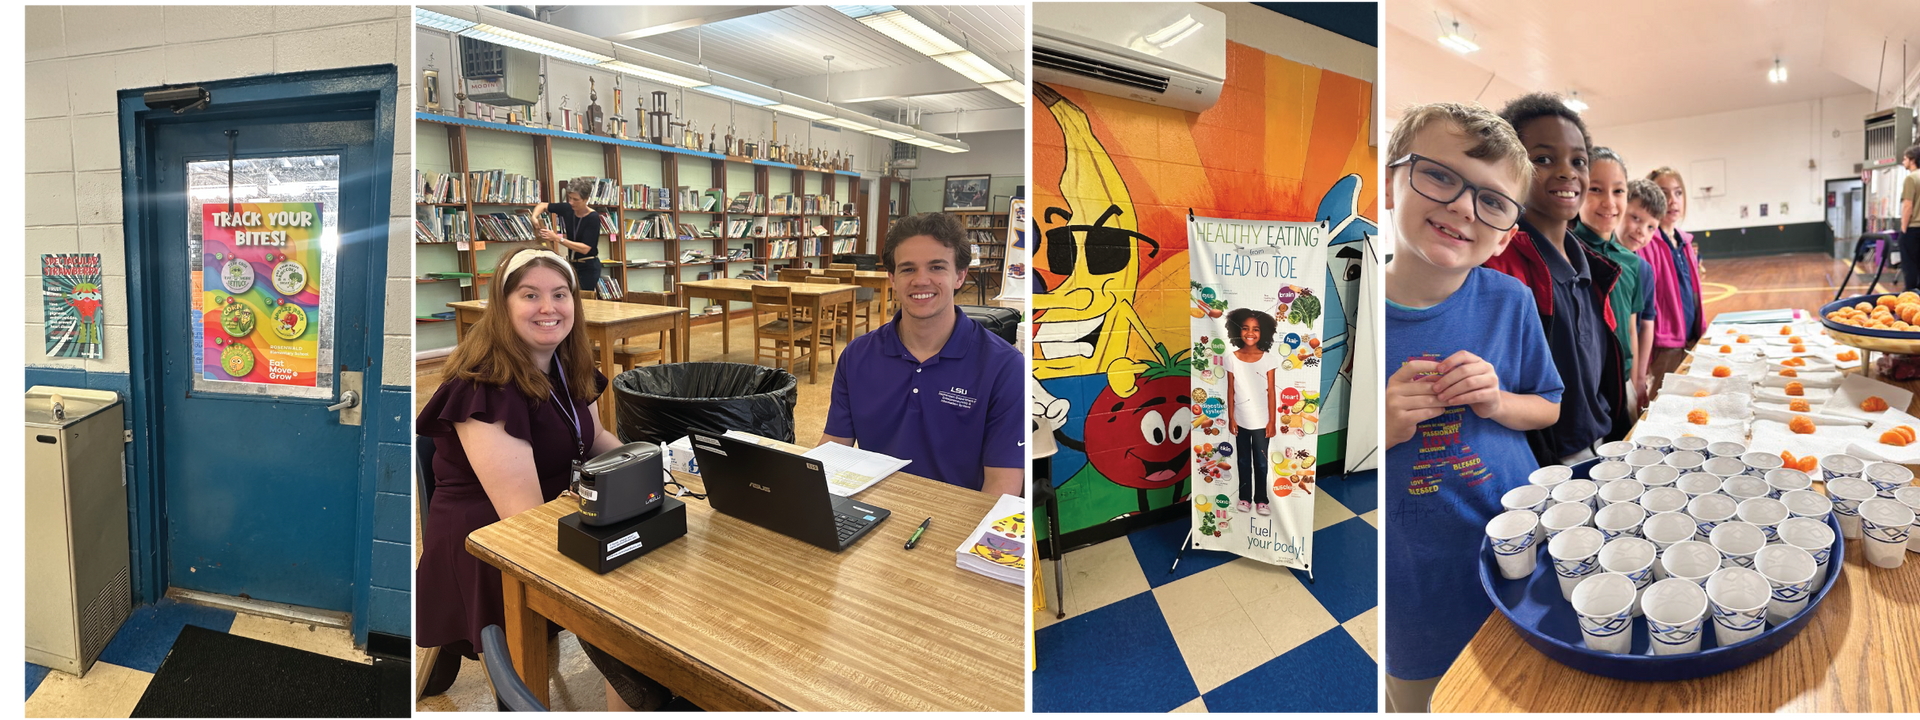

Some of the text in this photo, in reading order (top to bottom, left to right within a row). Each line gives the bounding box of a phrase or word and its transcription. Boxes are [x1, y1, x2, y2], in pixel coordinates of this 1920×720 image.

[212, 211, 312, 228] TRACK YOUR
[235, 230, 286, 246] BITES!
[1196, 222, 1319, 247] HEALTHY EATING
[44, 256, 98, 266] SPECTACULAR
[1214, 253, 1252, 276] HEAD
[1272, 256, 1298, 278] TOE
[44, 266, 100, 276] STRAWBERRY
[224, 304, 242, 316] CORN
[950, 386, 968, 395] LSU
[1422, 428, 1459, 437] PASSIONATE
[1422, 433, 1461, 448] LOVE
[1453, 458, 1481, 470] BLESSED
[749, 482, 771, 493] ASUS
[1408, 485, 1439, 495] BLESSED
[1250, 516, 1272, 537] Fuel
[1247, 532, 1305, 559] your body!
